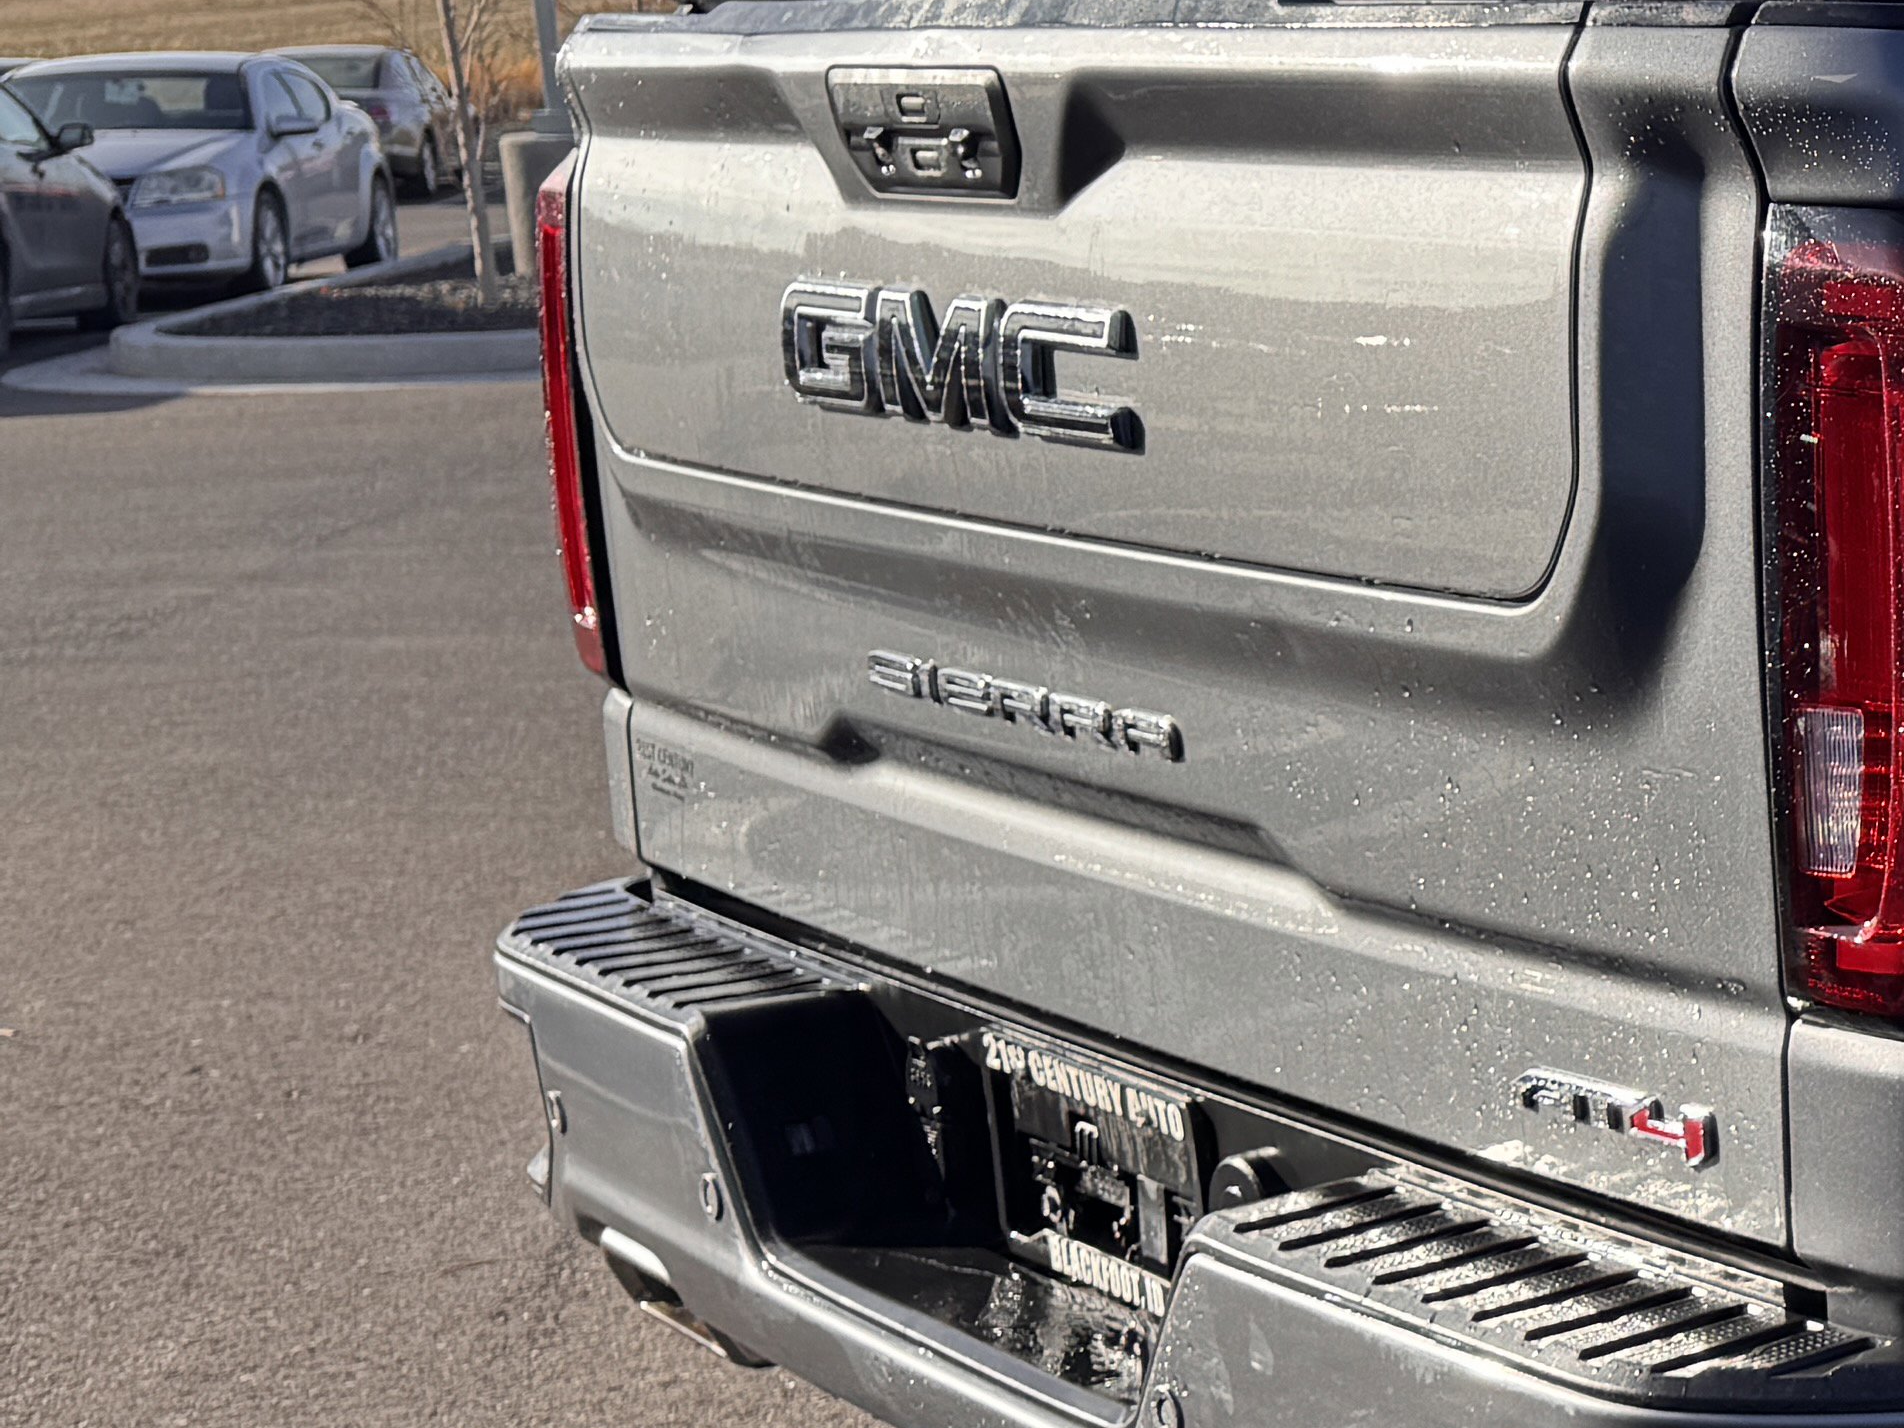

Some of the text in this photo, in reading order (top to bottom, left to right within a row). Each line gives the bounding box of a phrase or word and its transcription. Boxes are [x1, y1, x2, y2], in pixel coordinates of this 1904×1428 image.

[779, 278, 1145, 456] GMC
[867, 649, 1185, 763] SIERRA
[1027, 1050, 1124, 1117] CENTURY
[1125, 1087, 1186, 1142] AUTO
[1510, 1065, 1720, 1172] AT4
[1144, 1275, 1166, 1318] ID
